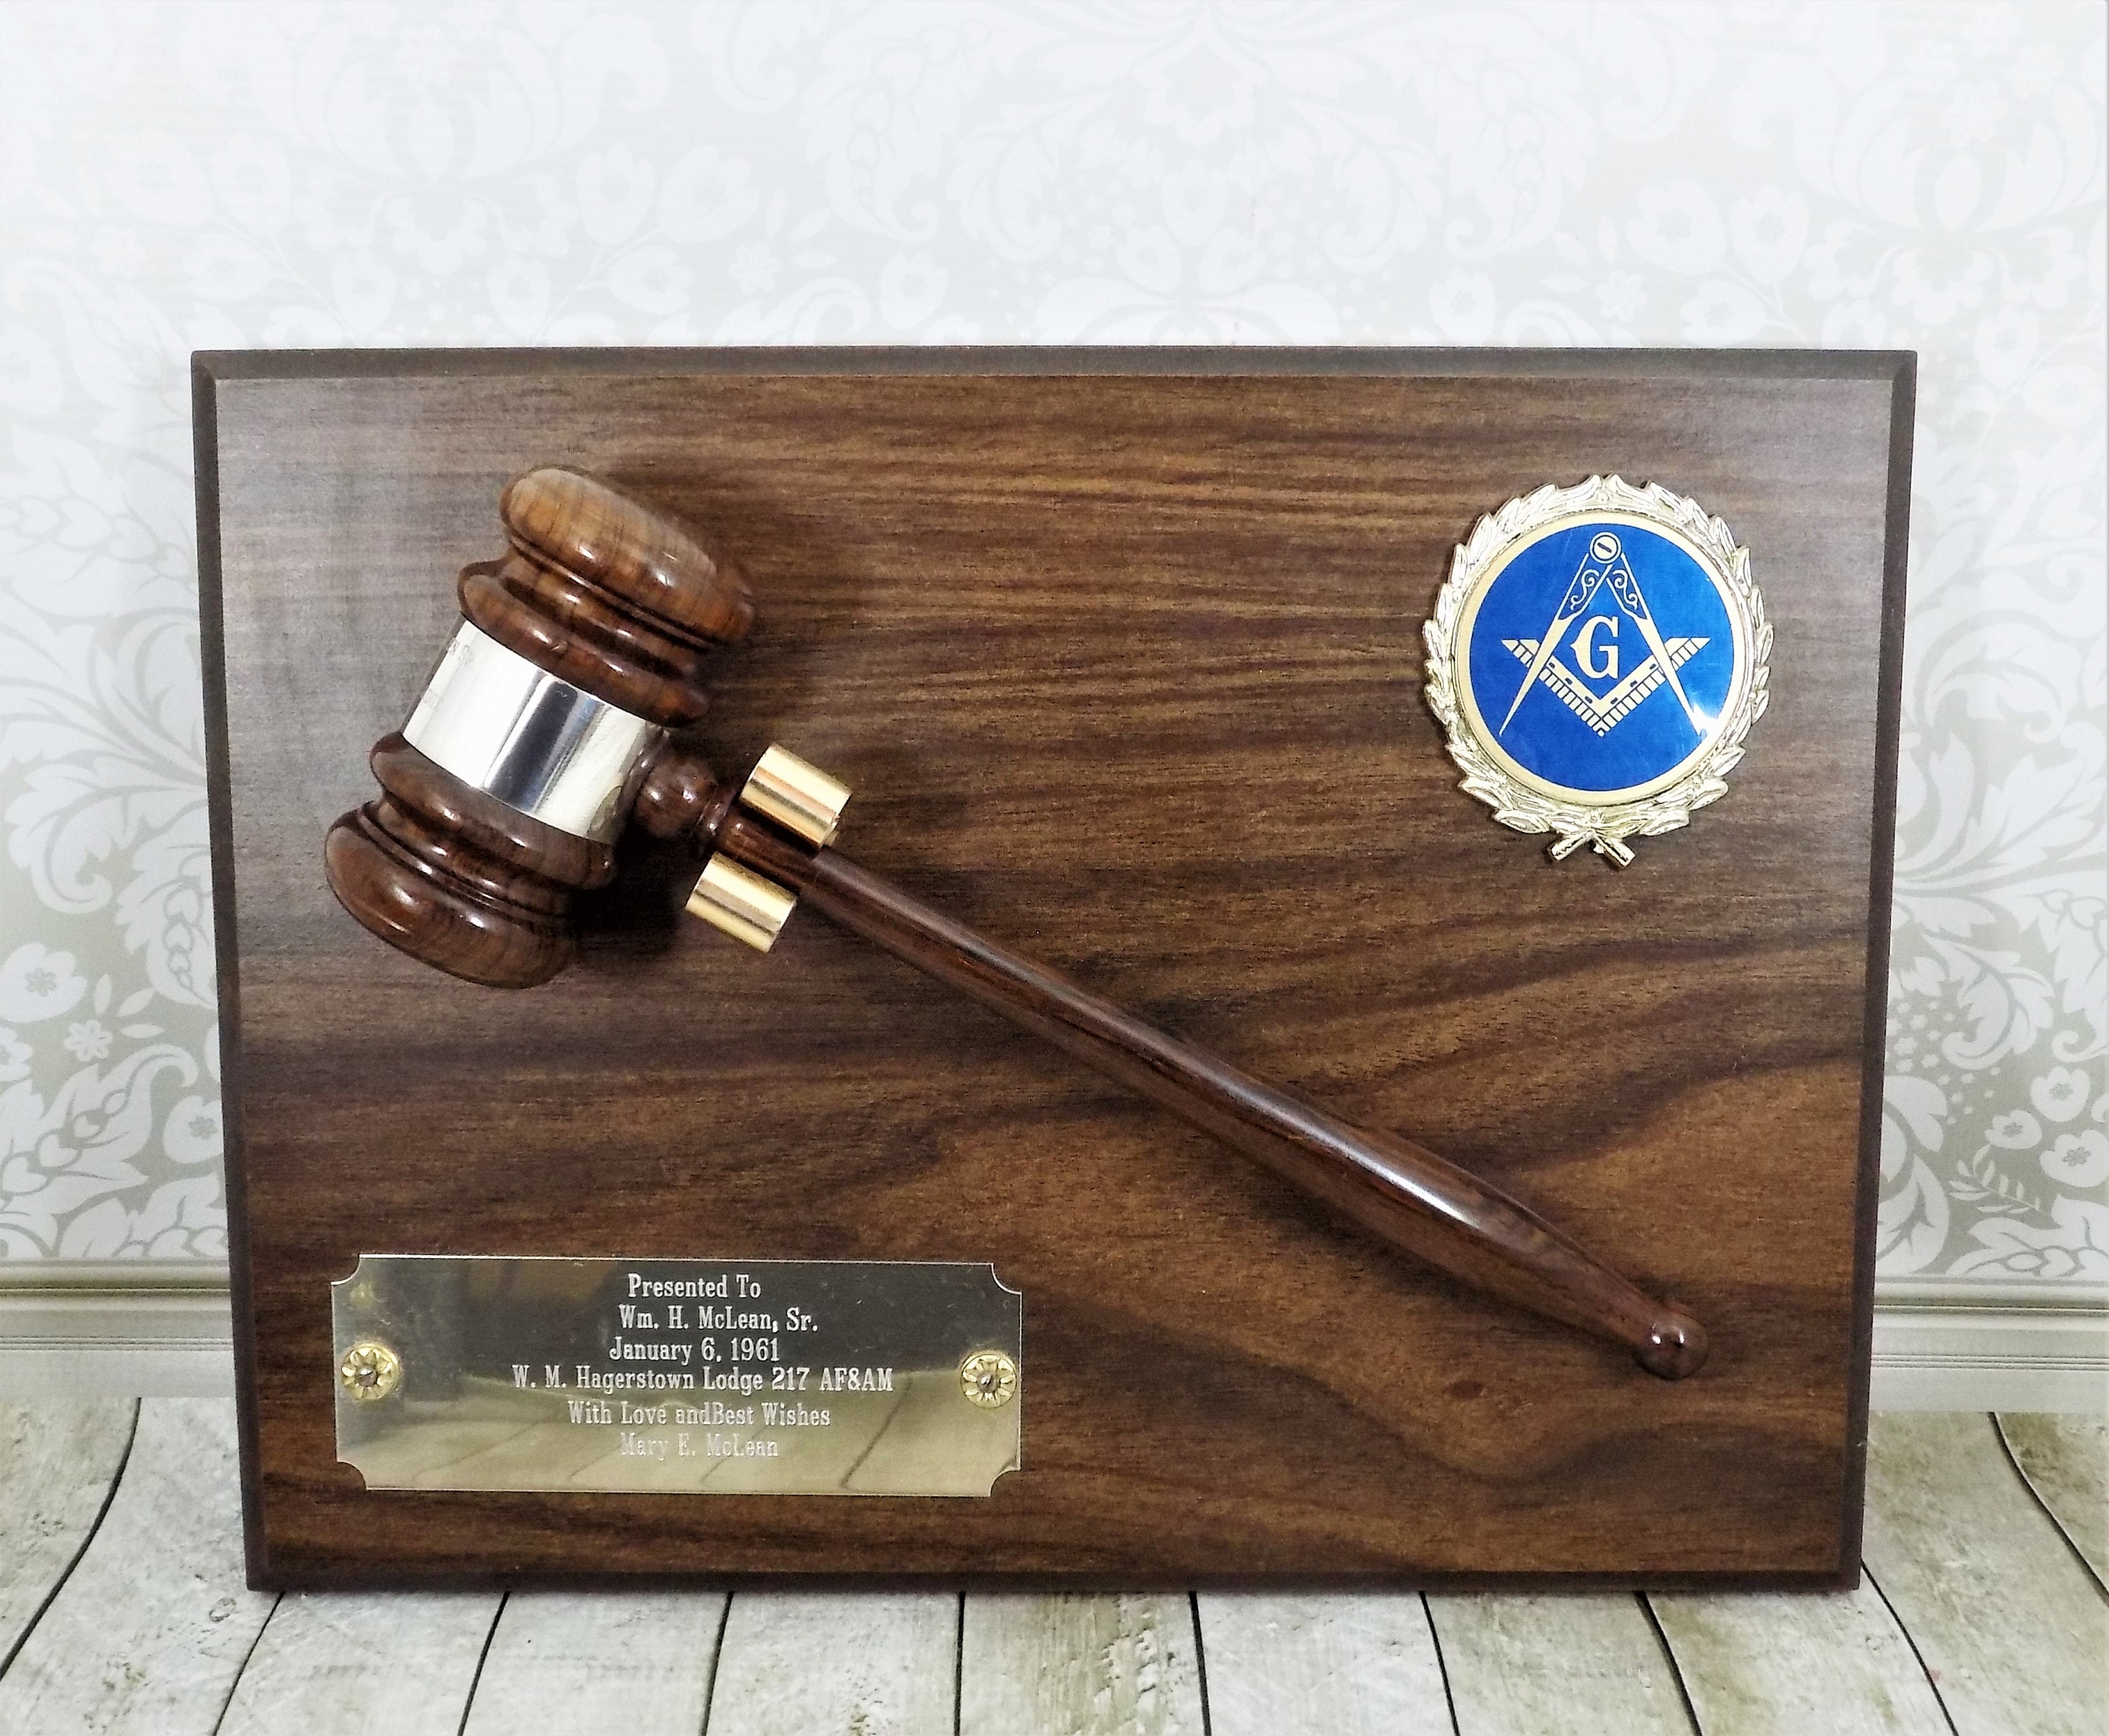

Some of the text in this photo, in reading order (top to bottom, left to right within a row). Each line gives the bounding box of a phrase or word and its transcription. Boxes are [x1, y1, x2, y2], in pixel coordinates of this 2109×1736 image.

[1571, 616, 1618, 679] G
[628, 1273, 761, 1298] Presented To
[619, 1304, 818, 1333] Wm. H. McLean, Sr.
[609, 1336, 692, 1366] January
[731, 1337, 780, 1361] 1961
[512, 1364, 893, 1396] W. M. Hagerstown Lodge 217 AF&AM
[567, 1400, 612, 1425] With
[621, 1401, 667, 1425] Love
[761, 1401, 831, 1426] Wishes
[620, 1432, 778, 1461] Mary E. McLean
